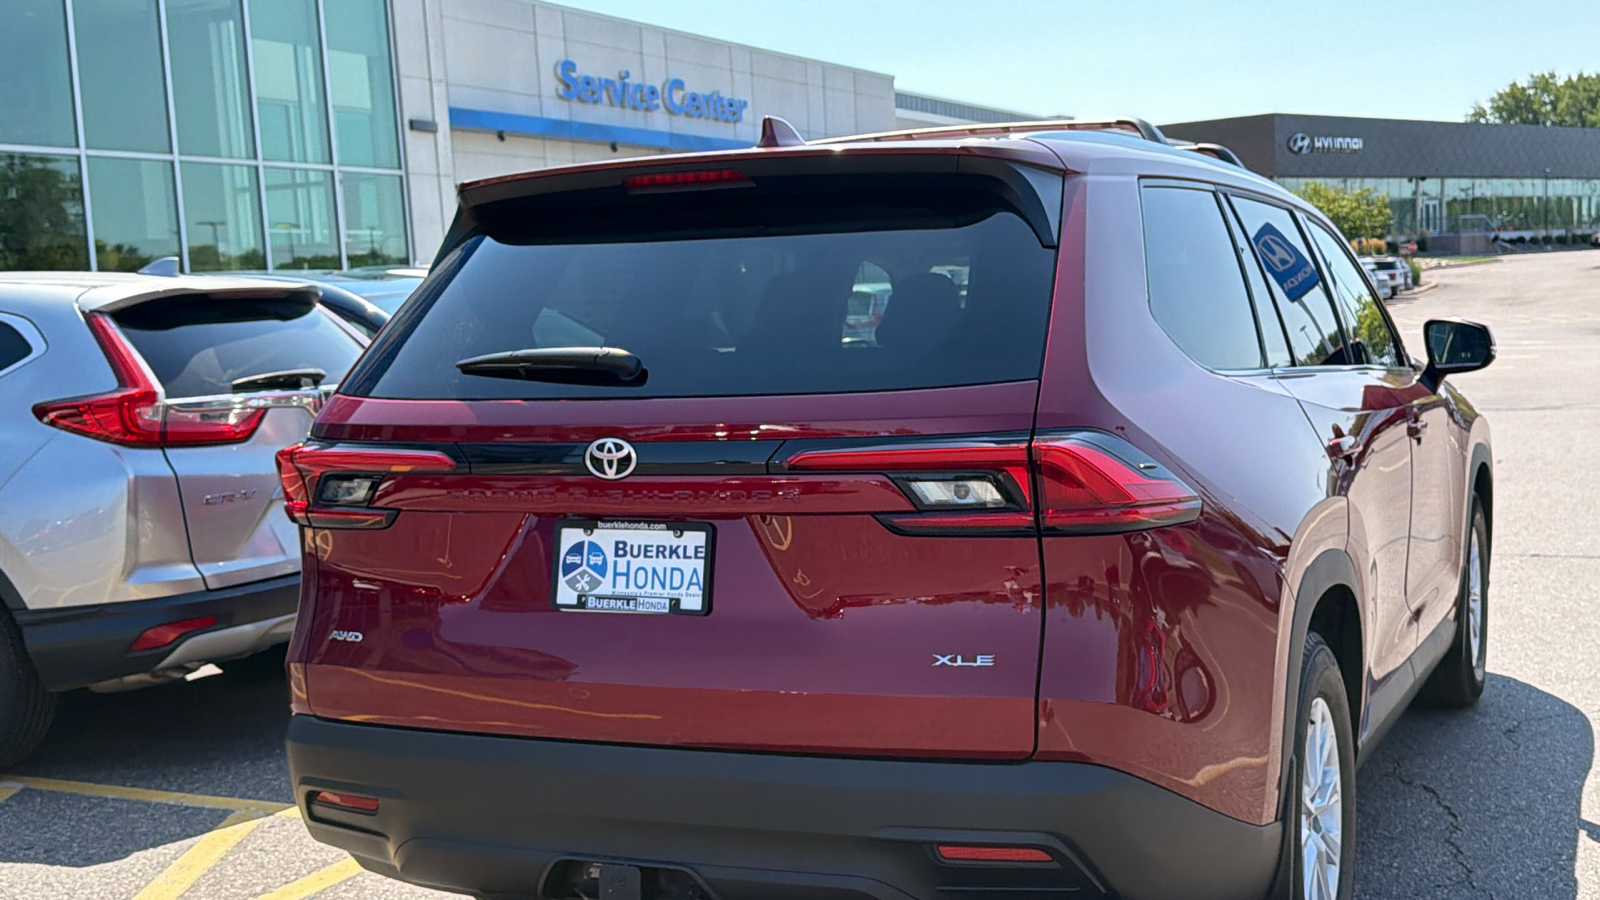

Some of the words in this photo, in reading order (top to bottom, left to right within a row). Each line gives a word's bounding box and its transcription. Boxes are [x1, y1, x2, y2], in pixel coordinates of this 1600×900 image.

[554, 59, 660, 112] Service
[662, 77, 748, 123] Center
[1314, 136, 1363, 150] HYUNDAI
[598, 521, 667, 530] buerklehonda.com
[614, 540, 704, 559] BUERKLE
[612, 560, 703, 591] HONDA
[329, 630, 363, 642] AWD
[932, 654, 995, 667] XLE
